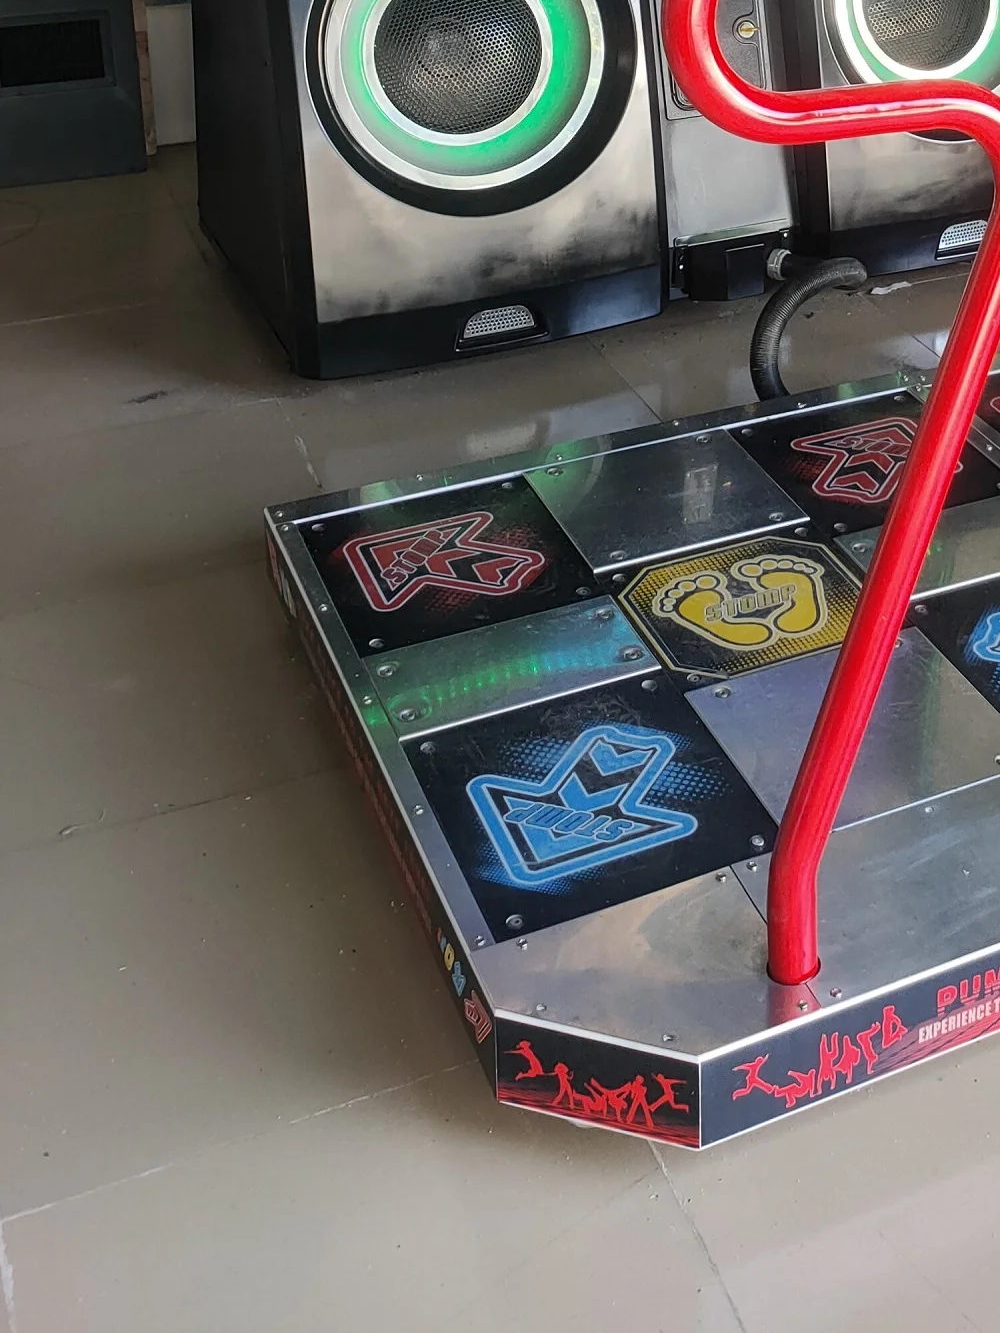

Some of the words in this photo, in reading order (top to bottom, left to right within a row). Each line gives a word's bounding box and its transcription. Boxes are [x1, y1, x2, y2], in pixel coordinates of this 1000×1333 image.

[381, 529, 447, 585] STOMP
[704, 583, 798, 622] STOMP
[503, 802, 636, 843] STOMP
[918, 1002, 993, 1043] EXPERIENCE
